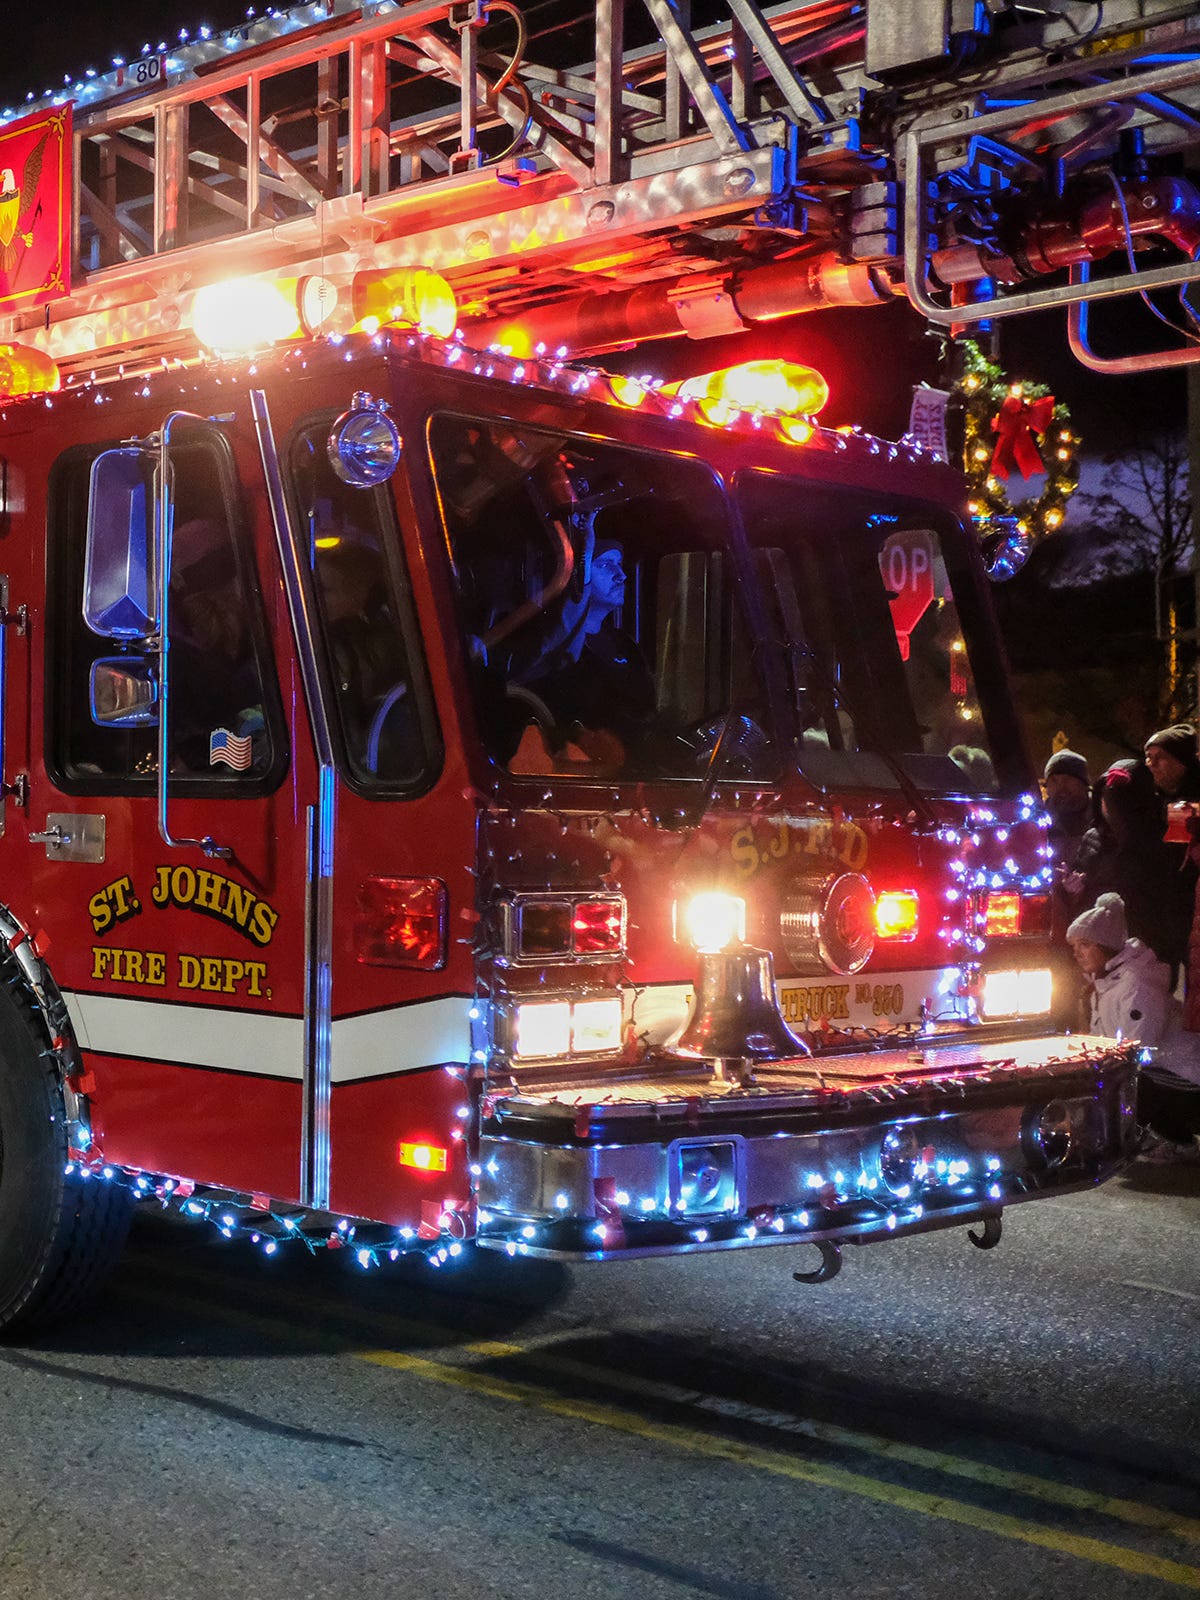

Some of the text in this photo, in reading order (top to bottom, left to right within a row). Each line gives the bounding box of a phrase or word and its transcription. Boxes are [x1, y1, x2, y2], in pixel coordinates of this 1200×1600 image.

[137, 59, 159, 83] 80
[889, 545, 929, 592] OP
[88, 866, 278, 944] ST. JOHNS
[91, 947, 272, 1000] FIRE DEPT.
[781, 985, 850, 1023] TRUCK
